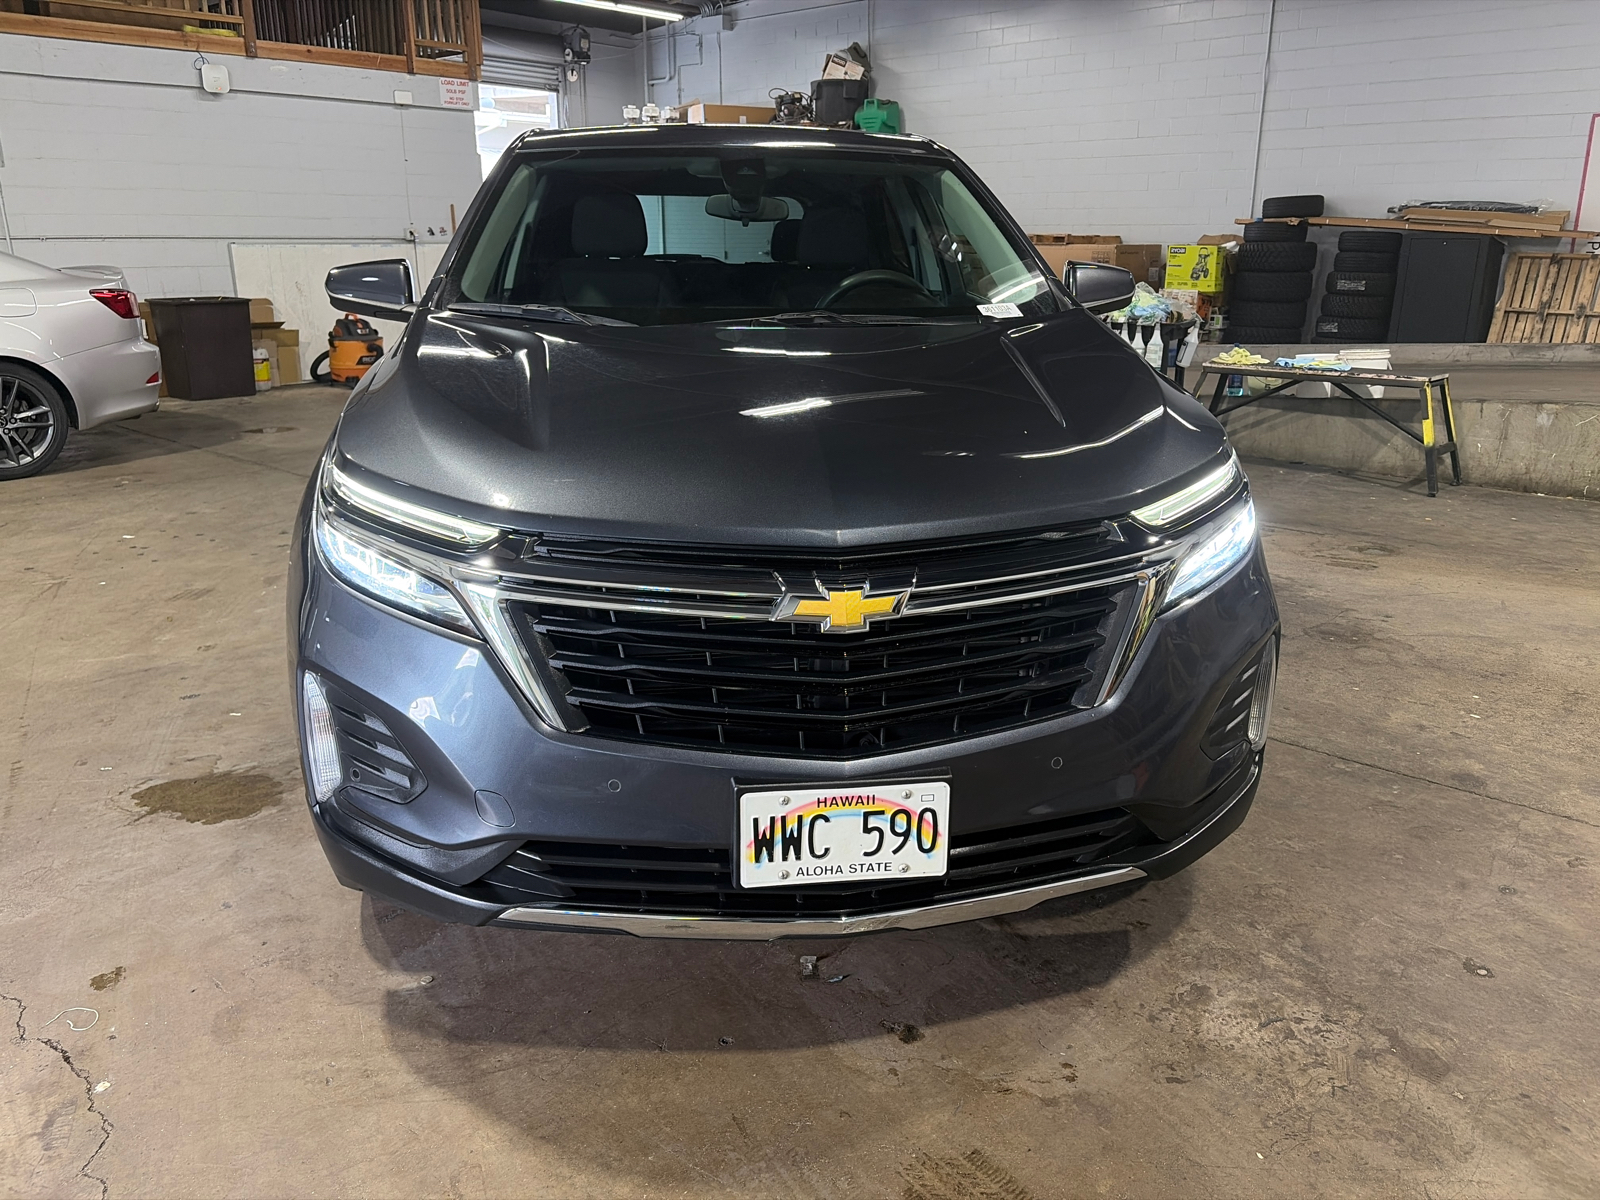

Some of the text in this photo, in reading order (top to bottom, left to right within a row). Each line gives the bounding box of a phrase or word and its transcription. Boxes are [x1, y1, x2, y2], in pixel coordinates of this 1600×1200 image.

[817, 794, 876, 808] HAWAII
[752, 807, 938, 864] WWC 590
[796, 862, 892, 877] ALOHA STATE
